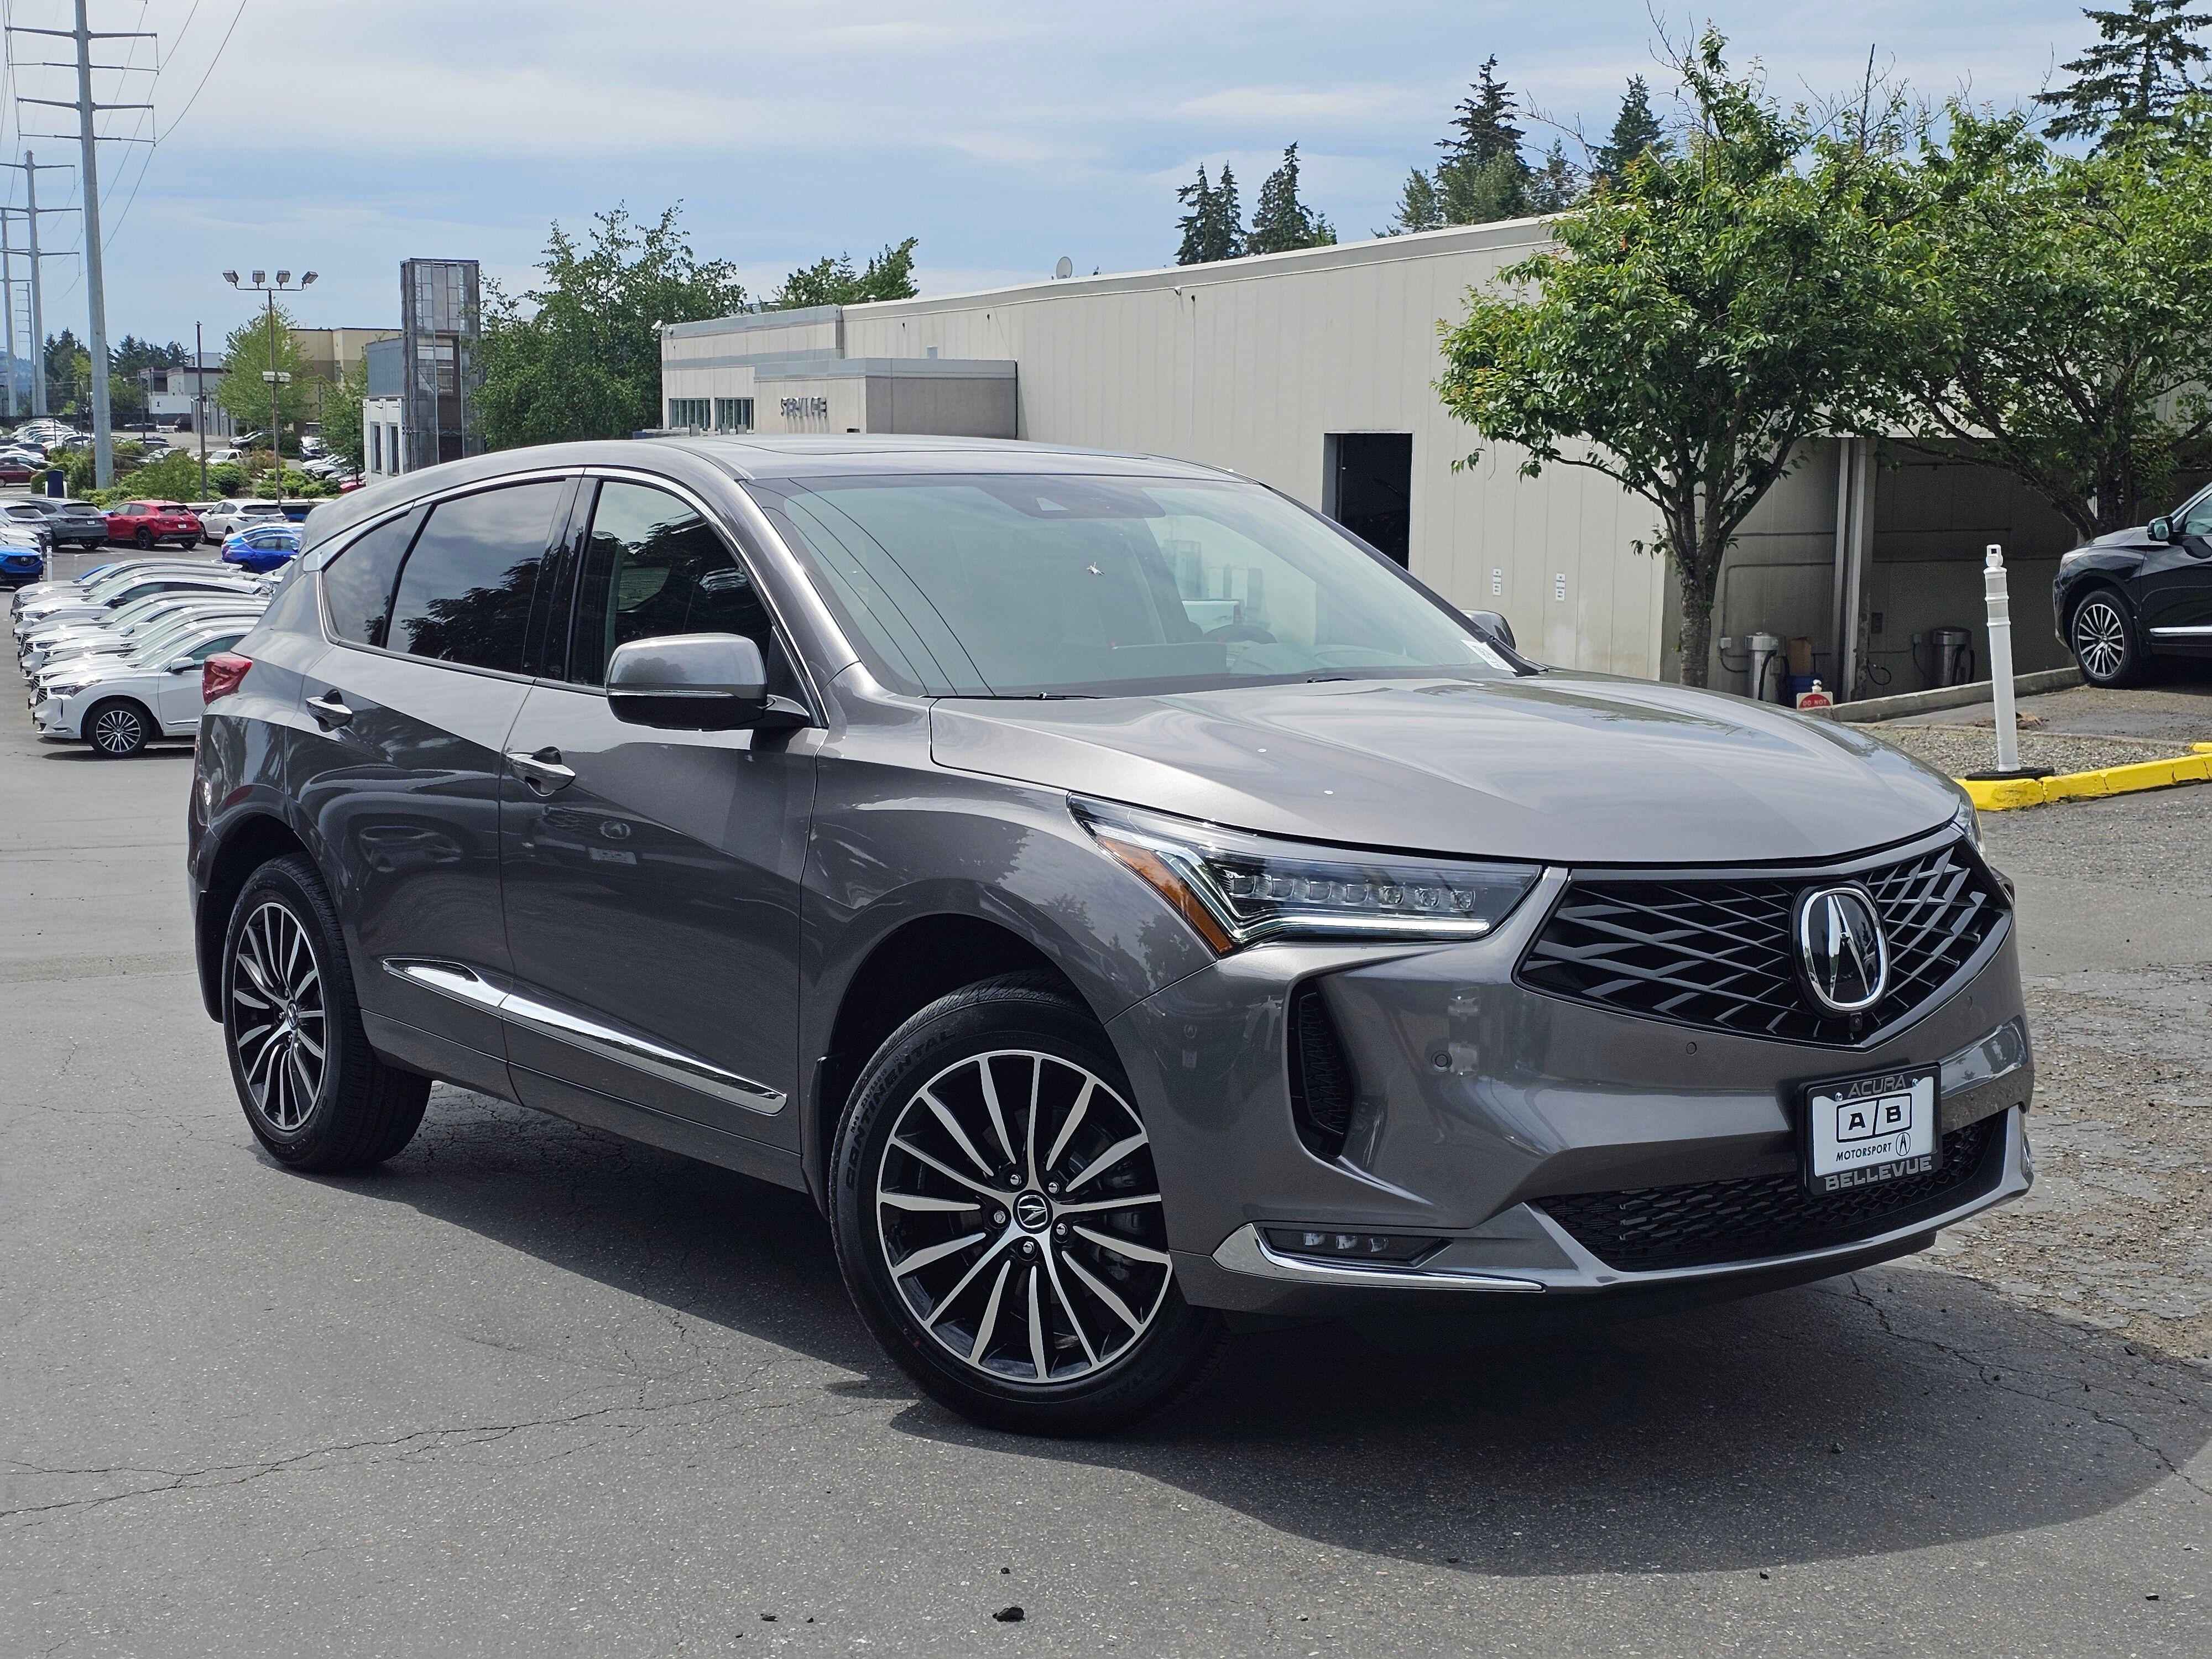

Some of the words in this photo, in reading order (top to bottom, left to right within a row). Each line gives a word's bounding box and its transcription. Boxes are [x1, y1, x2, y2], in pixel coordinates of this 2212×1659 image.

[780, 397, 827, 419] SERVICE
[1847, 1074, 1906, 1099] ACURA
[845, 1030, 956, 1191] CONTINENTAL
[1835, 1142, 1892, 1162] MOTORSPORT
[1824, 1156, 1932, 1191] BELLEVUE
